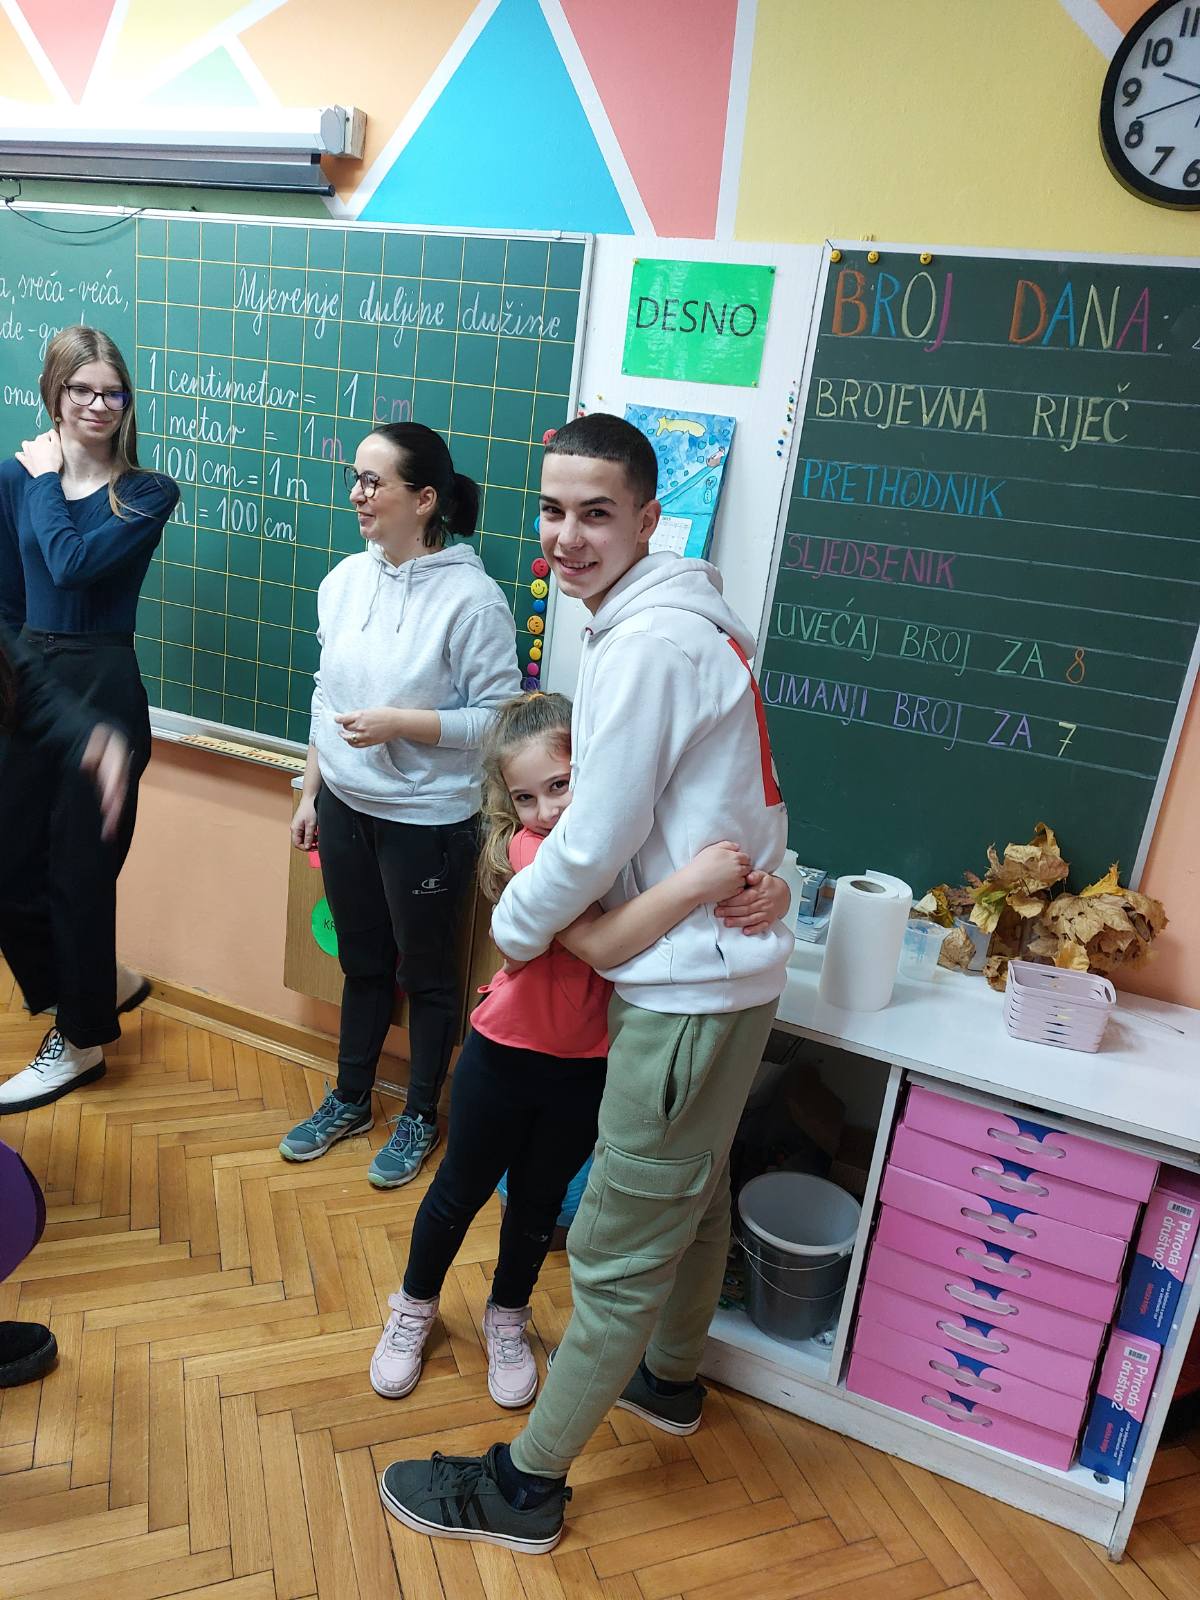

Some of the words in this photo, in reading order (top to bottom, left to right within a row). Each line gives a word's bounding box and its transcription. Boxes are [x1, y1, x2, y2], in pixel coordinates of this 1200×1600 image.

[1141, 37, 1174, 70] 10
[1122, 77, 1142, 107] 9
[1124, 120, 1144, 149] 8
[1149, 146, 1175, 176] 7
[1182, 159, 1200, 188] 6
[234, 267, 339, 340] Mjerenje
[359, 280, 445, 348] duljine
[462, 291, 561, 338] dužine
[635, 296, 758, 337] DESNO
[830, 269, 953, 353] BROJ
[149, 351, 157, 391] 1
[148, 397, 157, 433] 1
[169, 406, 246, 444] metar
[815, 378, 988, 432] BROJEVNA
[1032, 382, 1131, 452] RIJEČ
[803, 458, 1007, 517] PRETHODNIK
[785, 534, 957, 588] SLJEDBENIK
[776, 597, 879, 661] UVEĆAJ
[900, 624, 970, 676] BROJ
[996, 640, 1045, 678] ZA
[1065, 646, 1086, 684] 8
[763, 671, 868, 726] UMANJI
[893, 692, 961, 751] BROJ
[988, 711, 1032, 750] ZA
[1057, 721, 1077, 758] 7
[1154, 1216, 1175, 1260] društvo
[1167, 1220, 1191, 1266] Priroda
[1151, 1259, 1165, 1271] 2
[1113, 1360, 1134, 1401] društvo
[1127, 1365, 1149, 1407] Priroda
[1111, 1401, 1124, 1411] 2
